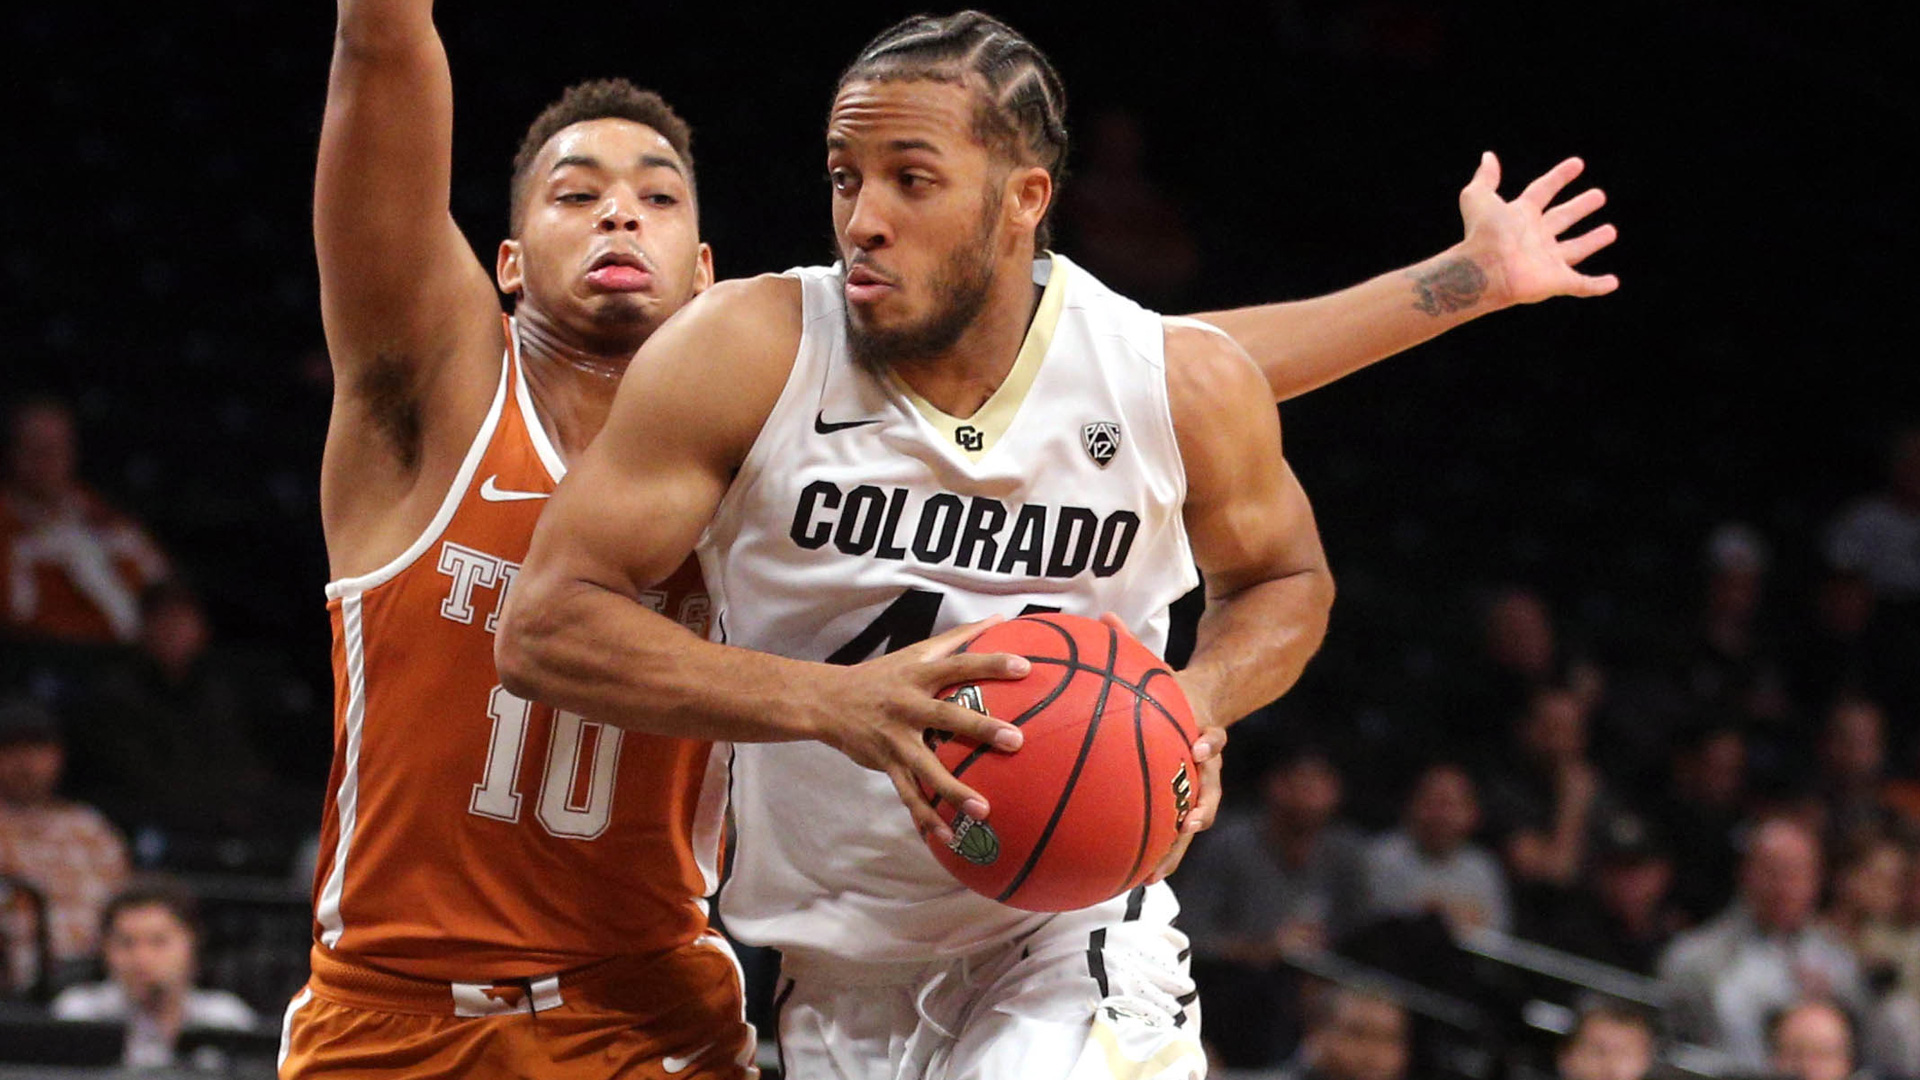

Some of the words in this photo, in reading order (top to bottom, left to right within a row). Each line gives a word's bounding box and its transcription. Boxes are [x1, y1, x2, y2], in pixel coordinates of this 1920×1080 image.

[954, 425, 984, 452] CU
[1093, 441, 1113, 459] 12
[790, 480, 1141, 578] COLORADO
[468, 684, 625, 841] 10
